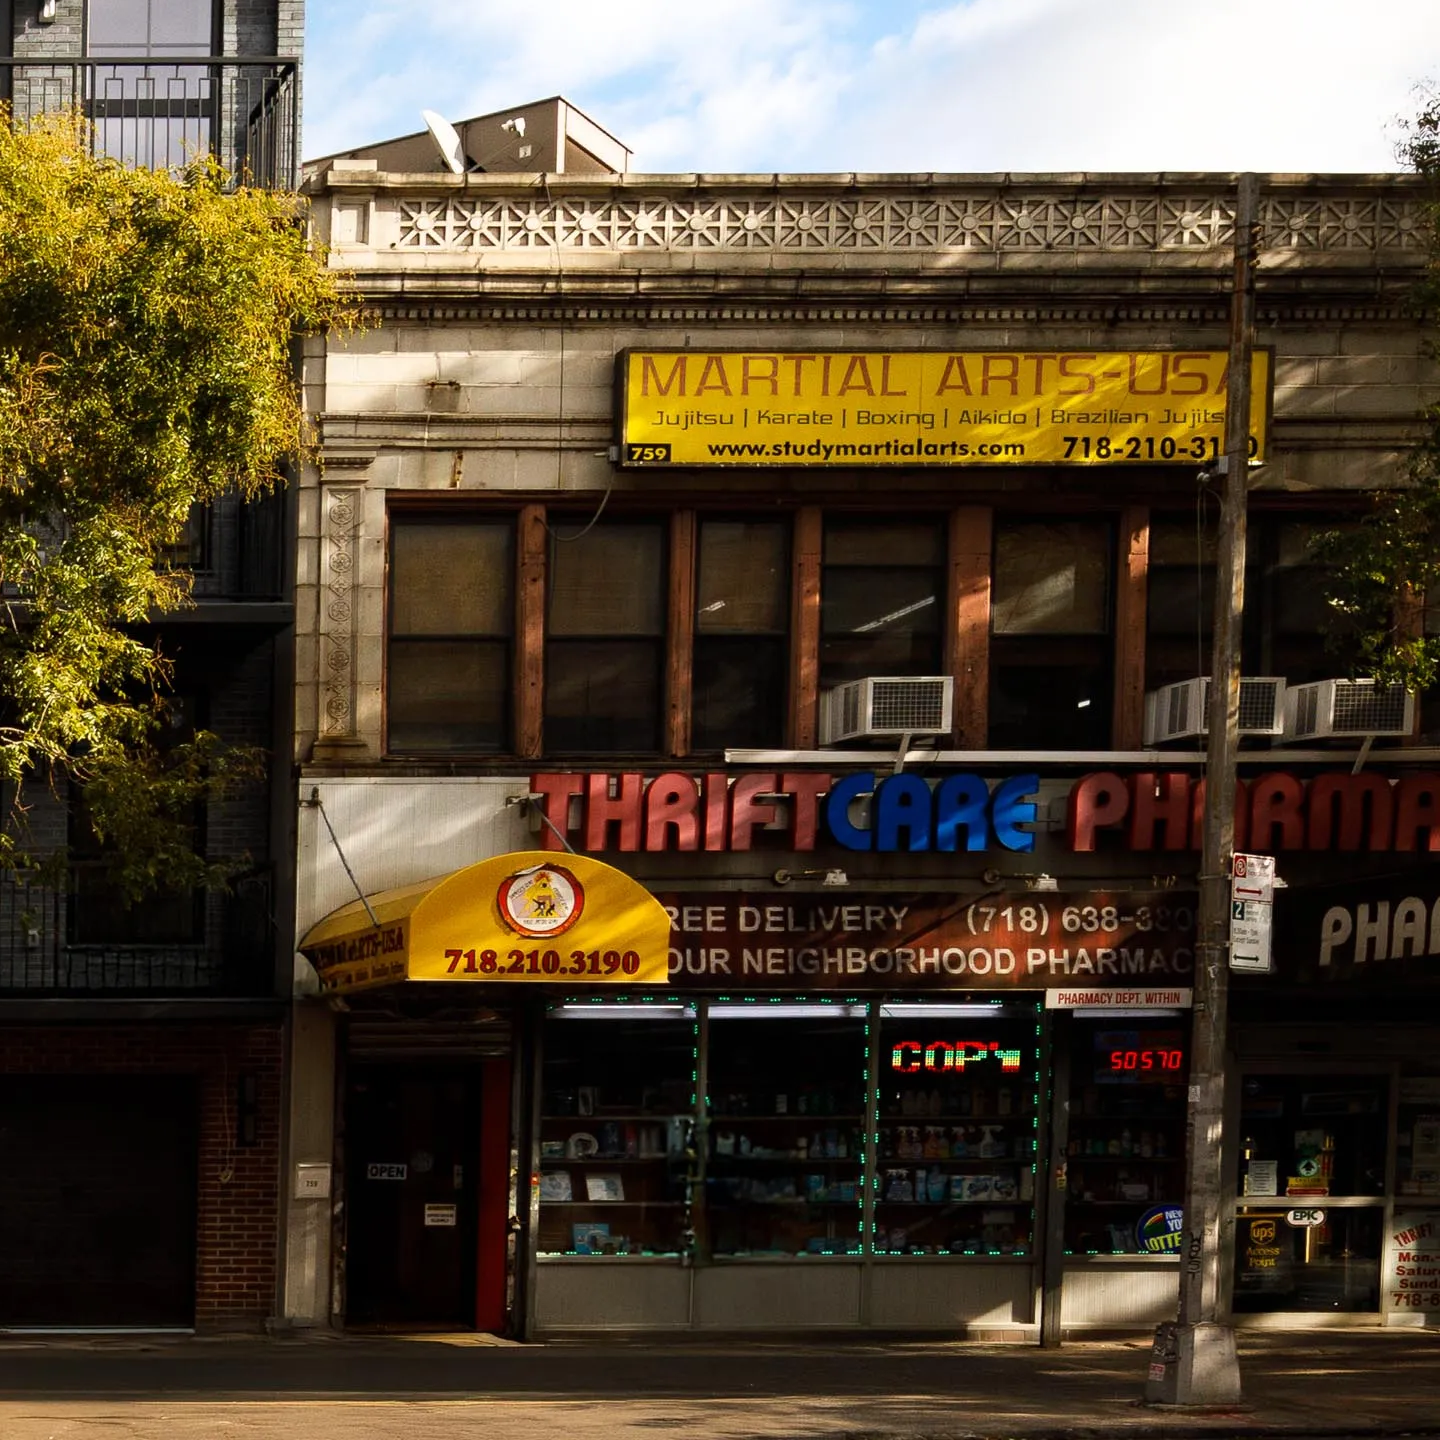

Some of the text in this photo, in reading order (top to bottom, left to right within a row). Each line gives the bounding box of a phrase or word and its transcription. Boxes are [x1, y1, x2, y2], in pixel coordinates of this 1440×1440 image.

[640, 355, 907, 397] MARTIAL
[651, 409, 1225, 430] Jujitsu Karate Boxing Aikido Brazilian Jujits
[631, 446, 667, 461] 759
[708, 436, 1258, 460] www.studymartialarts.com 718-210-310
[1068, 771, 1440, 852] PHRMA
[1235, 902, 1242, 918] 2
[665, 903, 1195, 936] REE DELIVERY (718) 638-380
[1318, 895, 1440, 967] PHA
[444, 949, 641, 975] 718.210.3190
[667, 946, 1194, 975] OUR NEIGHBORHOOD PHARMAC
[1058, 992, 1181, 1006] PHARMACY DEPT. WITHIN
[370, 1166, 405, 1177] OPEN
[1293, 1210, 1318, 1221] EPIC
[1167, 1219, 1184, 1232] YO
[1252, 1227, 1274, 1242] ups
[1144, 1231, 1182, 1252] LOTTE
[1396, 1265, 1440, 1277] Satur
[1399, 1278, 1440, 1289] Sund
